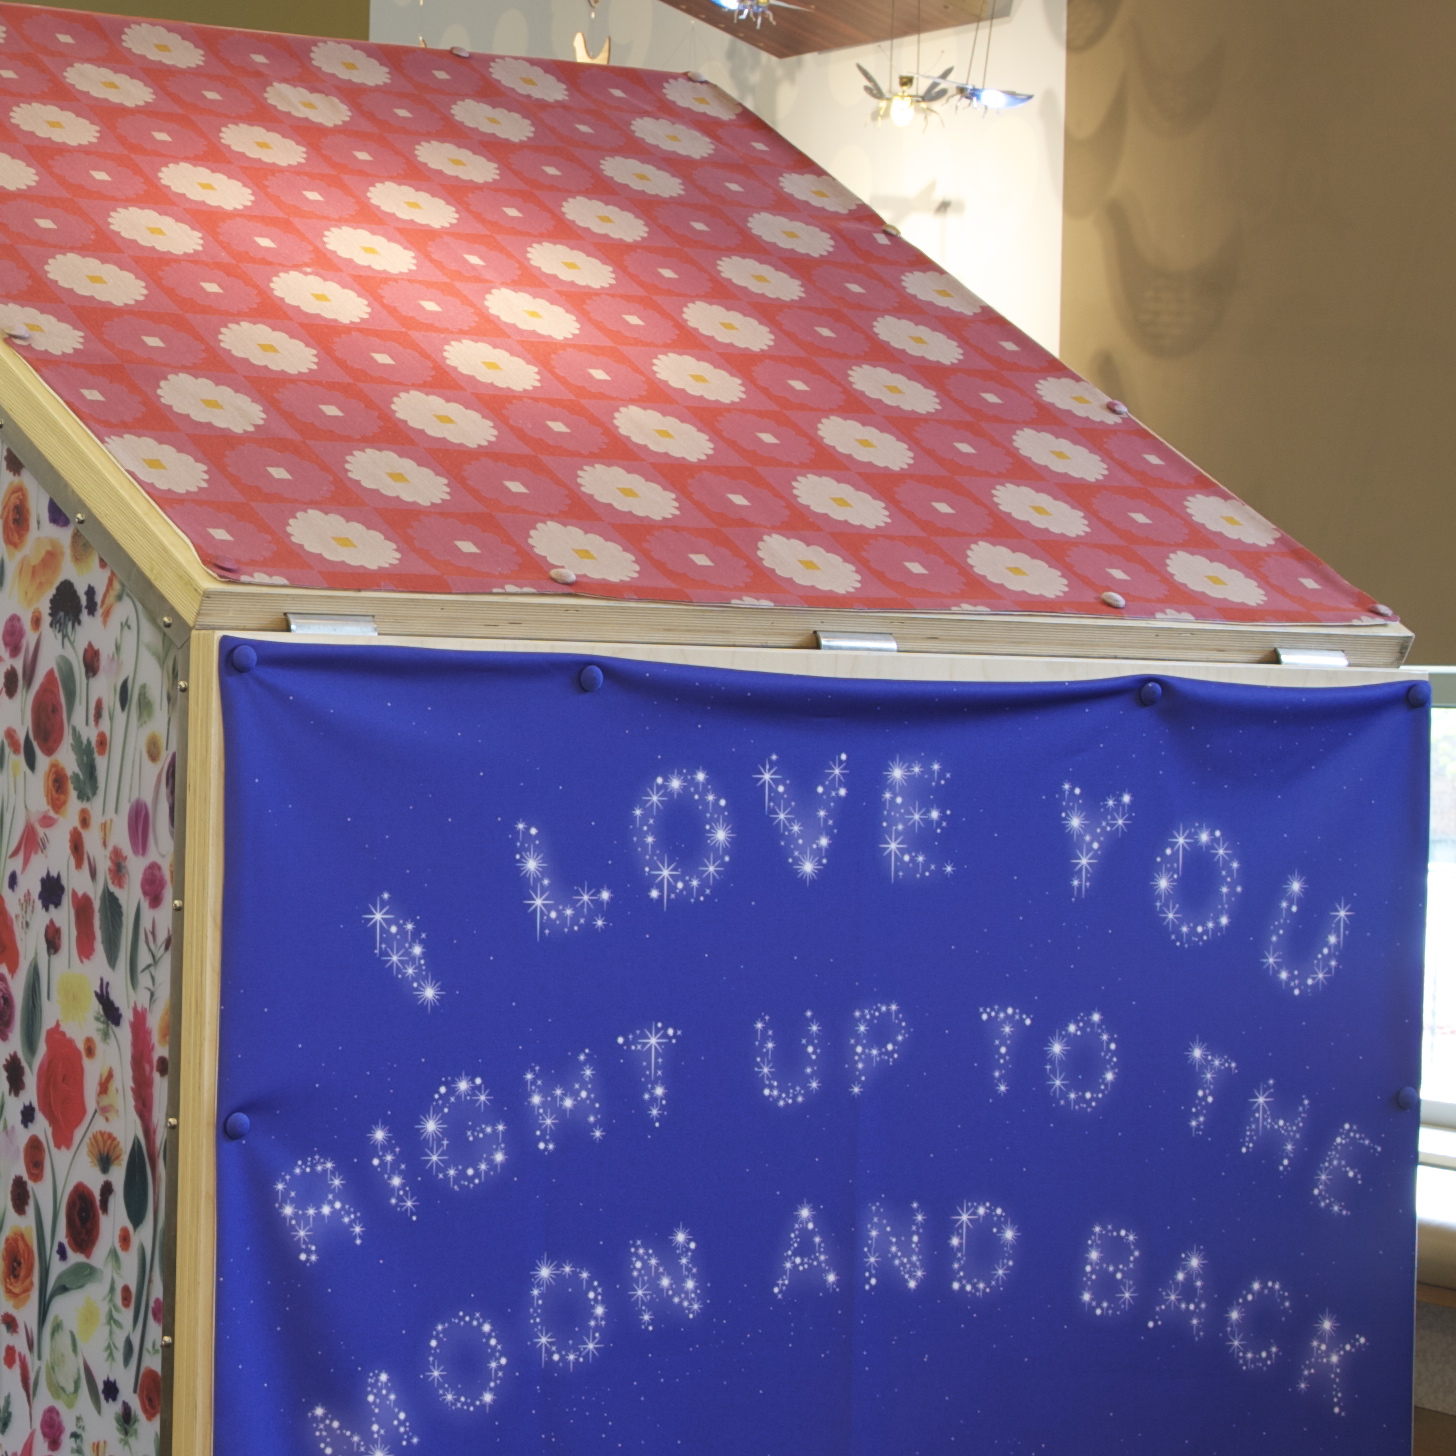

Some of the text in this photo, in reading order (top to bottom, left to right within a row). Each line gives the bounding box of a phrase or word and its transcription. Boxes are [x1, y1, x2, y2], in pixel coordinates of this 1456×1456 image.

[514, 751, 956, 940] LOVE
[1059, 779, 1357, 996] YOU
[274, 1001, 1382, 1265] RIGHT UP TO THE
[773, 1200, 1016, 1297] AND
[1081, 1224, 1368, 1415] BACK
